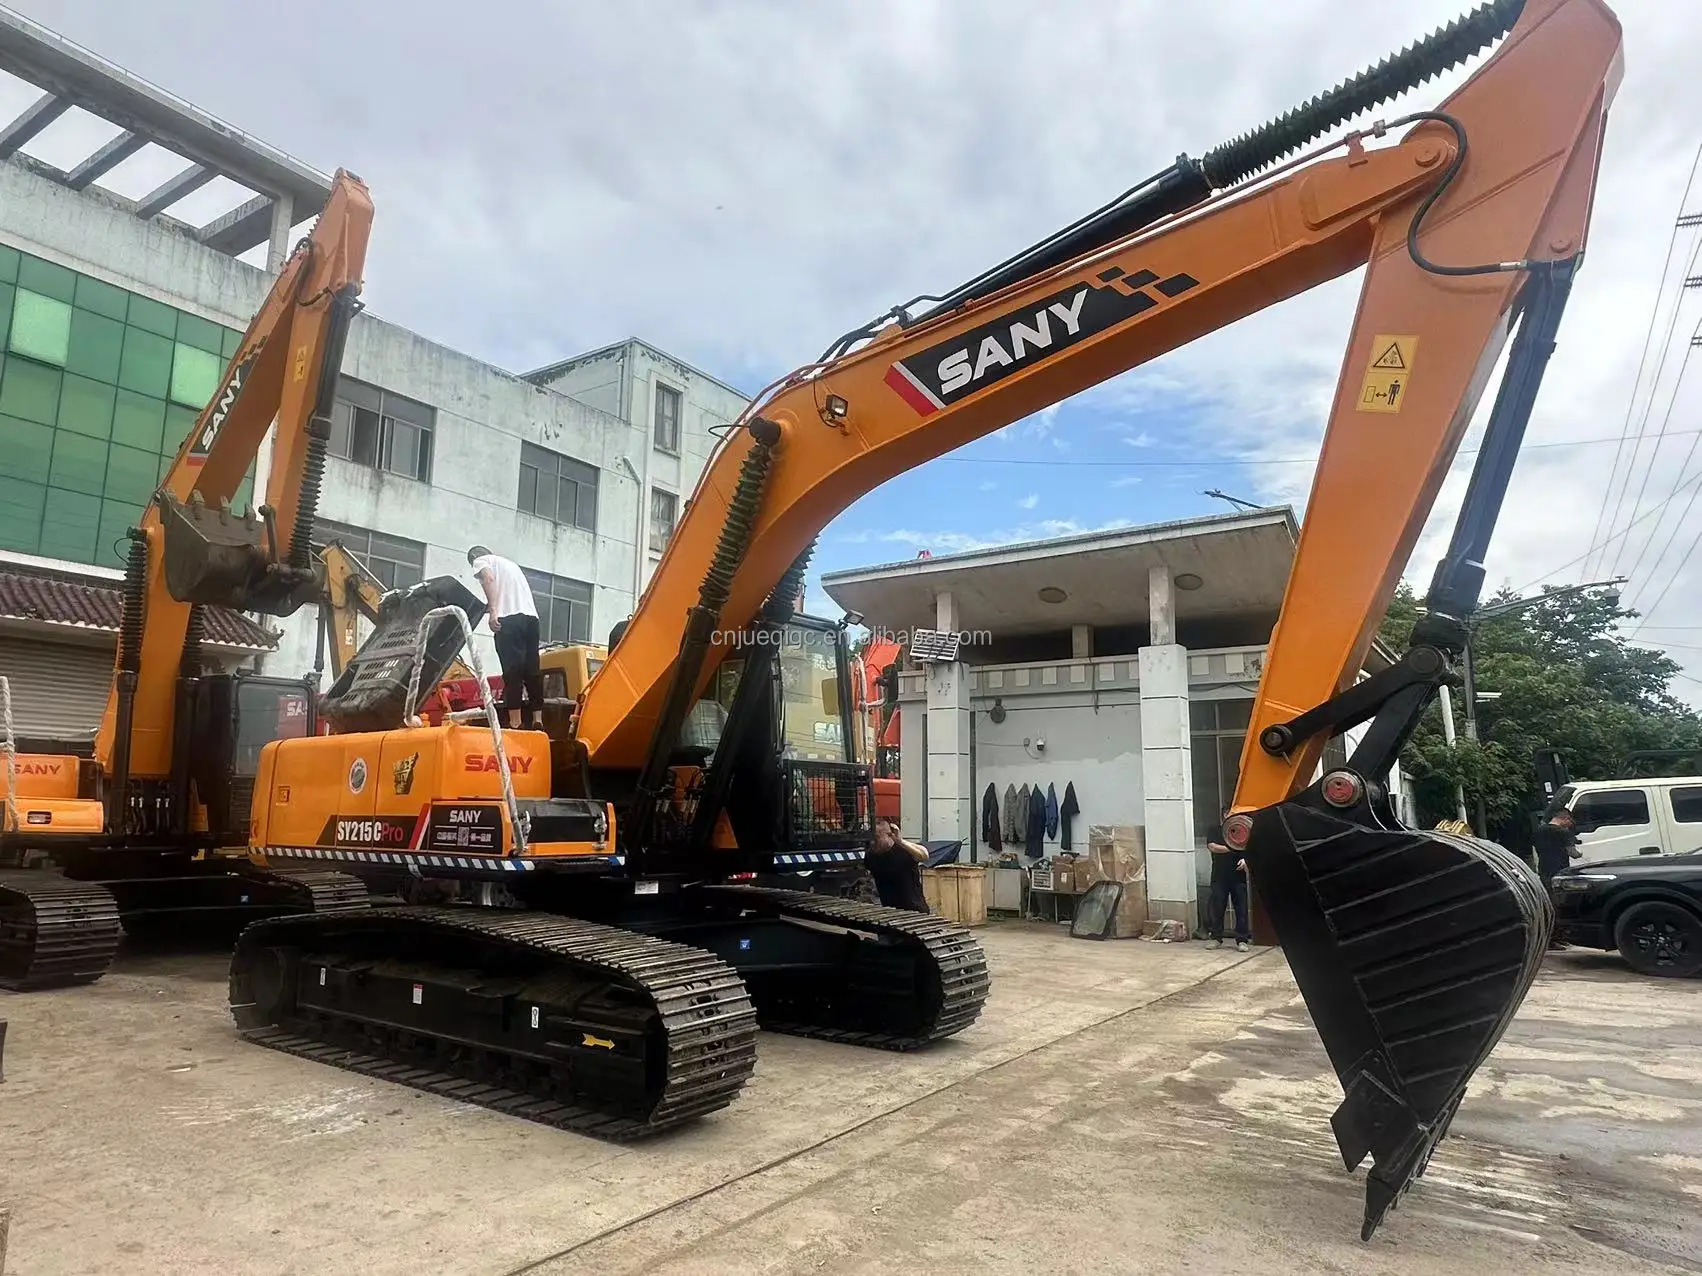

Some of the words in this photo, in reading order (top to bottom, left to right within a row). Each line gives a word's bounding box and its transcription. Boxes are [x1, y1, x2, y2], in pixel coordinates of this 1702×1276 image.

[937, 288, 1089, 395] SANY
[201, 367, 241, 451] SANY
[449, 809, 481, 823] SANY
